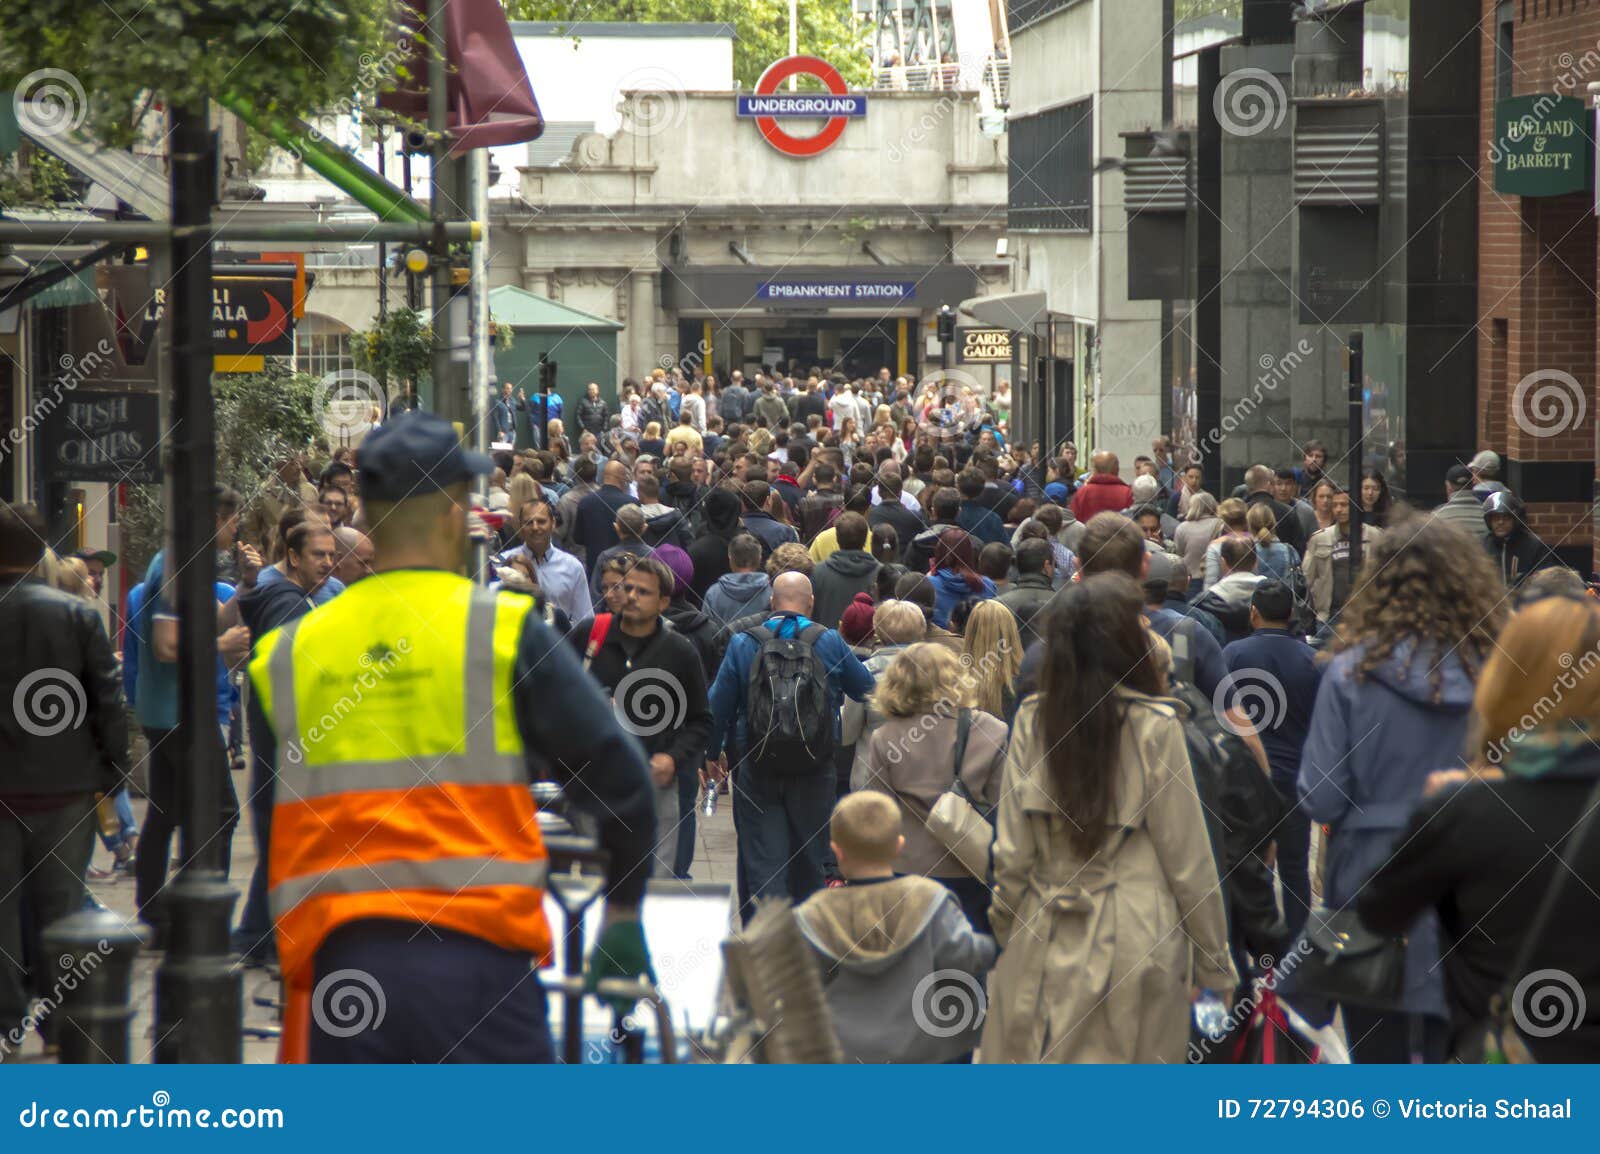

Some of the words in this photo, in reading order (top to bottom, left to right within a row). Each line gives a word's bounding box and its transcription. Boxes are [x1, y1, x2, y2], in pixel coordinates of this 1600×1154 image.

[747, 98, 857, 112] UNDERGROUND
[1507, 120, 1574, 137] HOLLAND
[1533, 135, 1547, 152] &
[1506, 153, 1573, 170] BARRETT
[768, 284, 851, 297] EMBANKMENT
[855, 284, 904, 296] STATION
[966, 333, 1010, 345] CARDS
[962, 345, 1013, 357] GALORE
